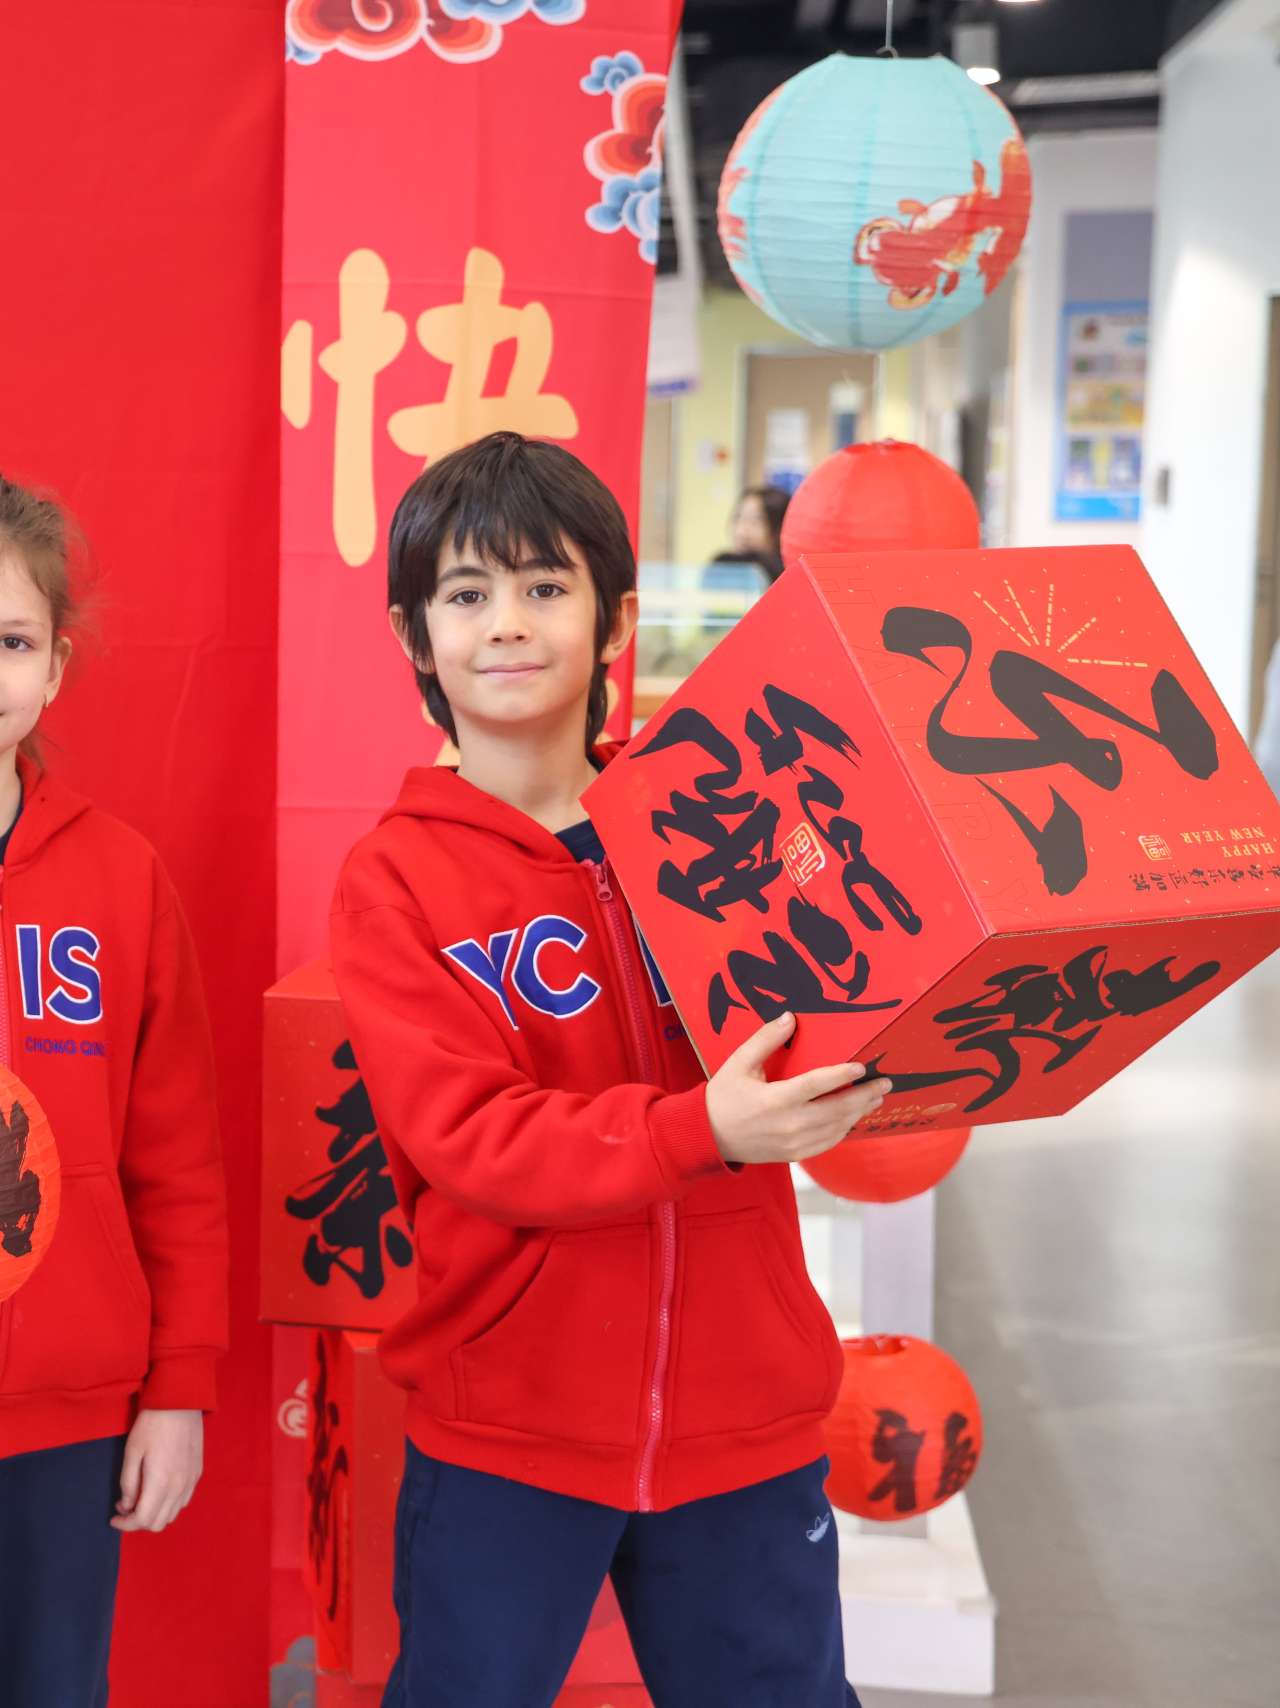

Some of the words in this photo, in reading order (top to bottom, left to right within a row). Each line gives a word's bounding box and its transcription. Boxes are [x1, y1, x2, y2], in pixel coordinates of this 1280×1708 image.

[281, 247, 579, 567] 快
[779, 822, 826, 887] 福
[1179, 829, 1224, 844] YEAR
[1221, 841, 1276, 858] HAPPY
[1229, 826, 1266, 841] NEW
[16, 924, 103, 1025] IS
[440, 914, 602, 1031] YC
[24, 1035, 77, 1056] CHONG
[80, 1040, 109, 1057] QIN
